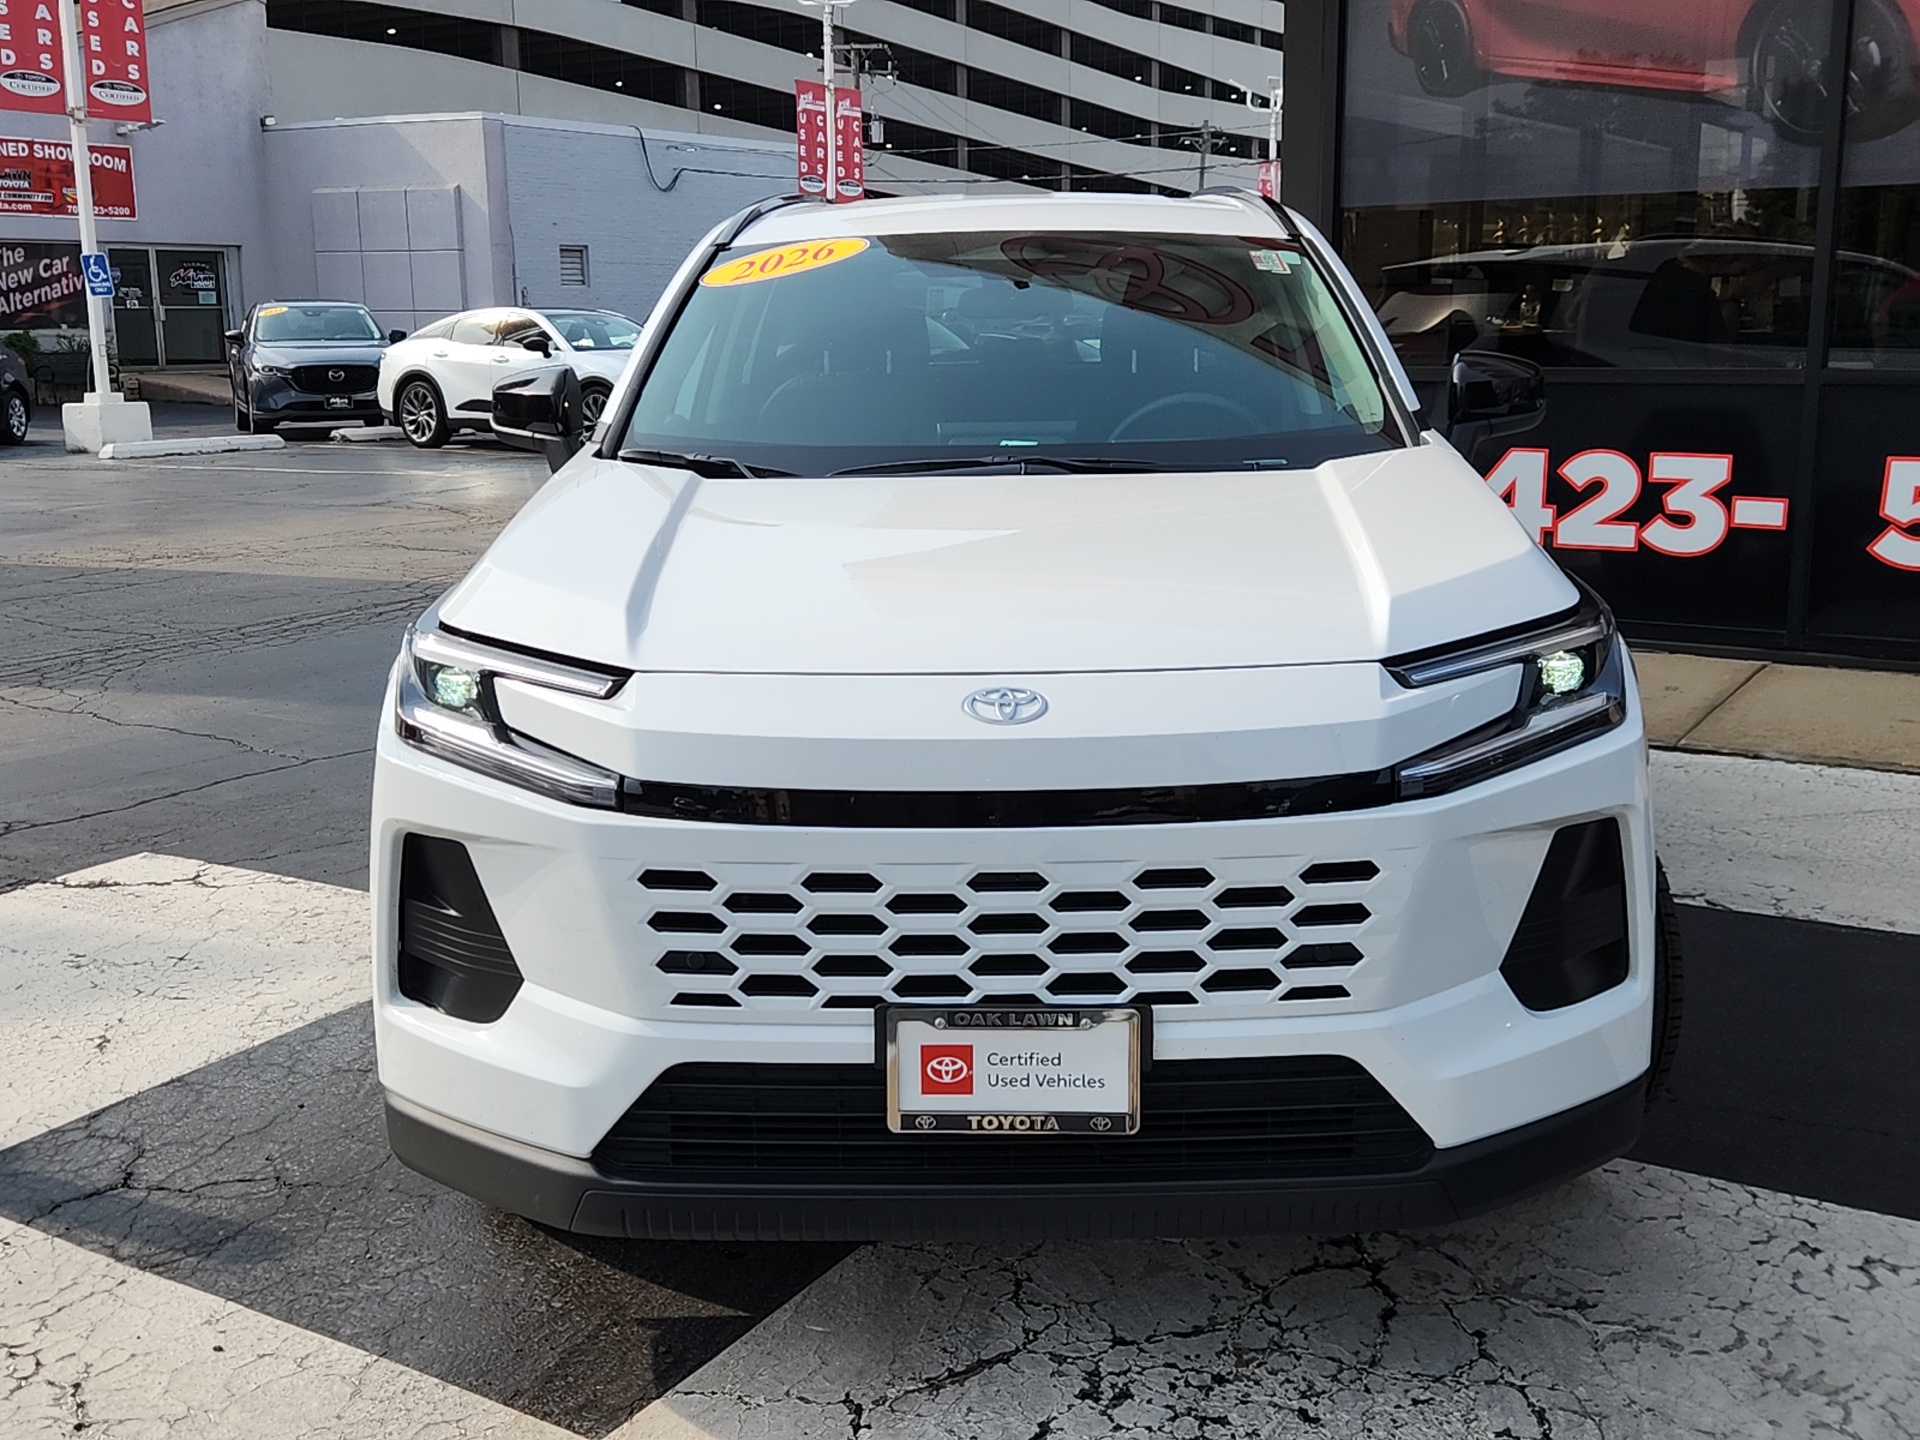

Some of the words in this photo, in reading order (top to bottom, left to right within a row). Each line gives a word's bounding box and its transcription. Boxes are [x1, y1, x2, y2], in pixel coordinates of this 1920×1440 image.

[0, 0, 16, 66] SED
[87, 0, 106, 75] SED
[33, 144, 127, 173] SHOOOM
[799, 112, 808, 173] USED
[816, 115, 825, 174] CARS
[836, 119, 846, 177] USED
[853, 121, 861, 179] CARS
[0, 247, 25, 267] he
[39, 255, 70, 278] Car
[731, 240, 838, 282] 2026
[0, 273, 83, 315] Alternativ
[954, 1013, 1003, 1026] OAK
[1009, 1013, 1074, 1026] LAWN
[987, 1052, 1062, 1067] Certified
[988, 1073, 1030, 1088] Used
[1035, 1073, 1106, 1089] Vehicles
[967, 1115, 1060, 1131] TOYOTA
